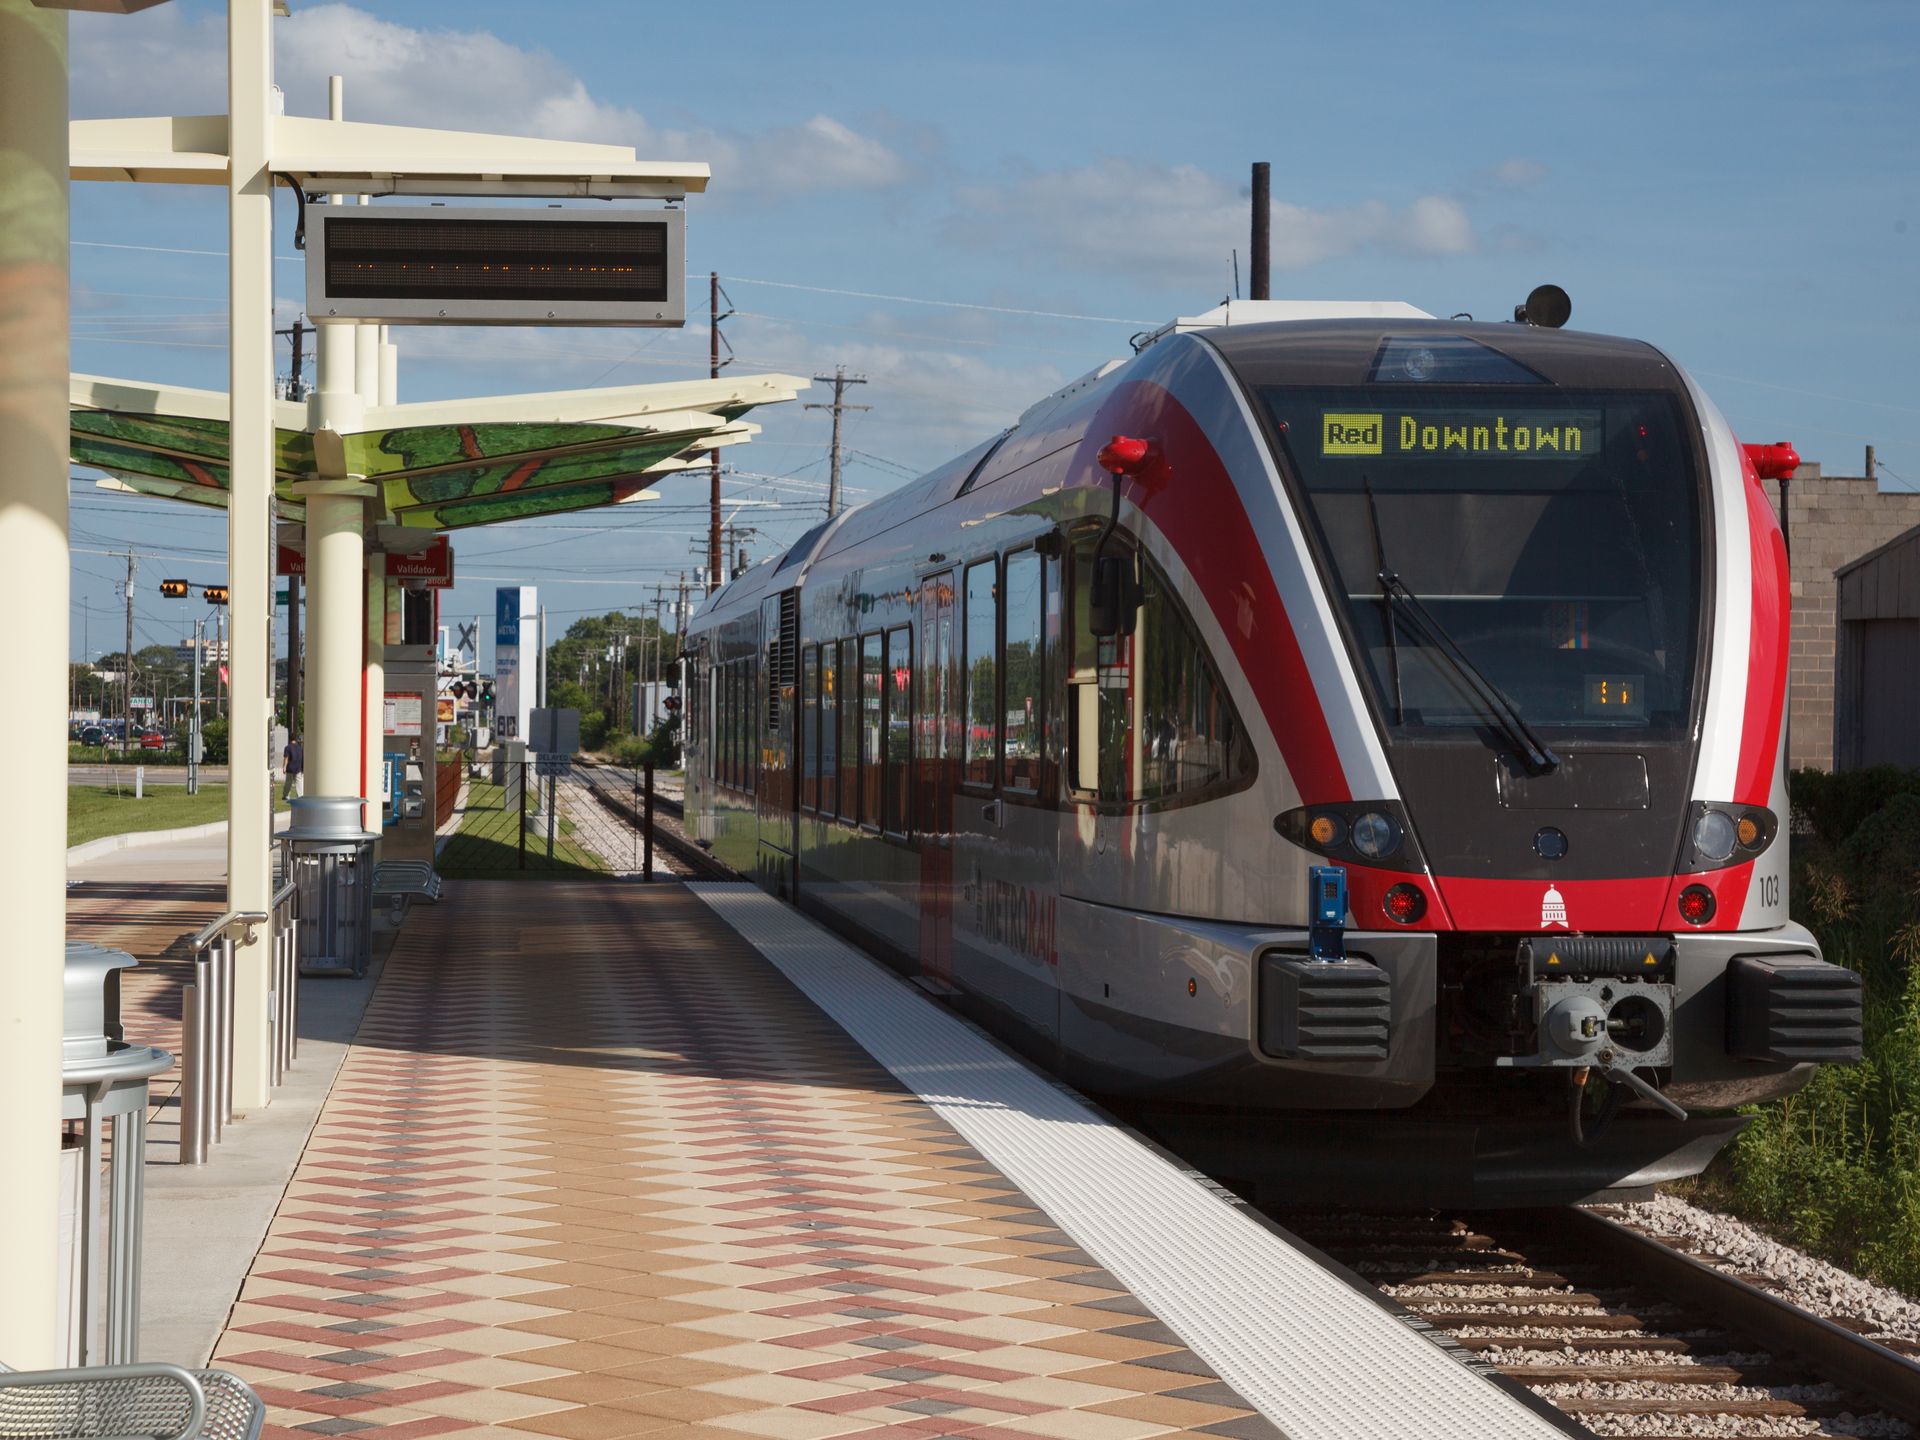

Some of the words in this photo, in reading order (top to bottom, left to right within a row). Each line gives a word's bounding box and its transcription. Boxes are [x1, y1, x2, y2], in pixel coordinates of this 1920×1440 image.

[1328, 423, 1378, 445] Red
[1400, 416, 1581, 451] Downtown
[397, 564, 436, 575] Validator
[1759, 874, 1779, 908] 103
